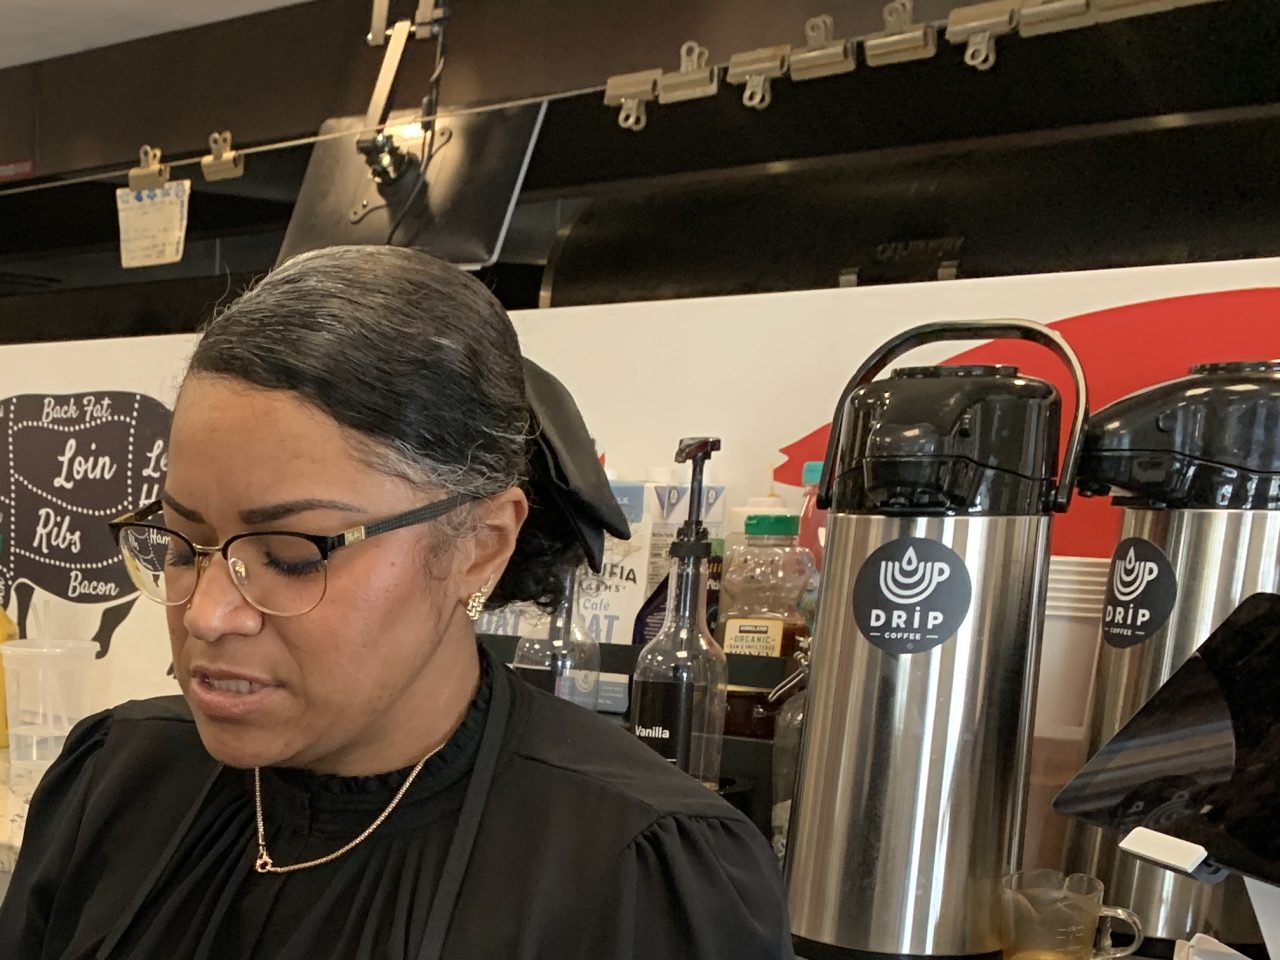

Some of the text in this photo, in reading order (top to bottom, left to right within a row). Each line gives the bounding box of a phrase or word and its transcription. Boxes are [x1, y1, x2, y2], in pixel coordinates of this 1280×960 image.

[41, 395, 112, 423] Back Fat
[53, 438, 117, 489] Loin
[142, 439, 169, 478] Le
[32, 508, 81, 554] Ribs
[68, 570, 119, 597] Bacon
[587, 613, 620, 645] AT
[734, 635, 771, 644] ORGANIC
[884, 631, 922, 641] COFFEE
[635, 724, 671, 739] Vanilla
